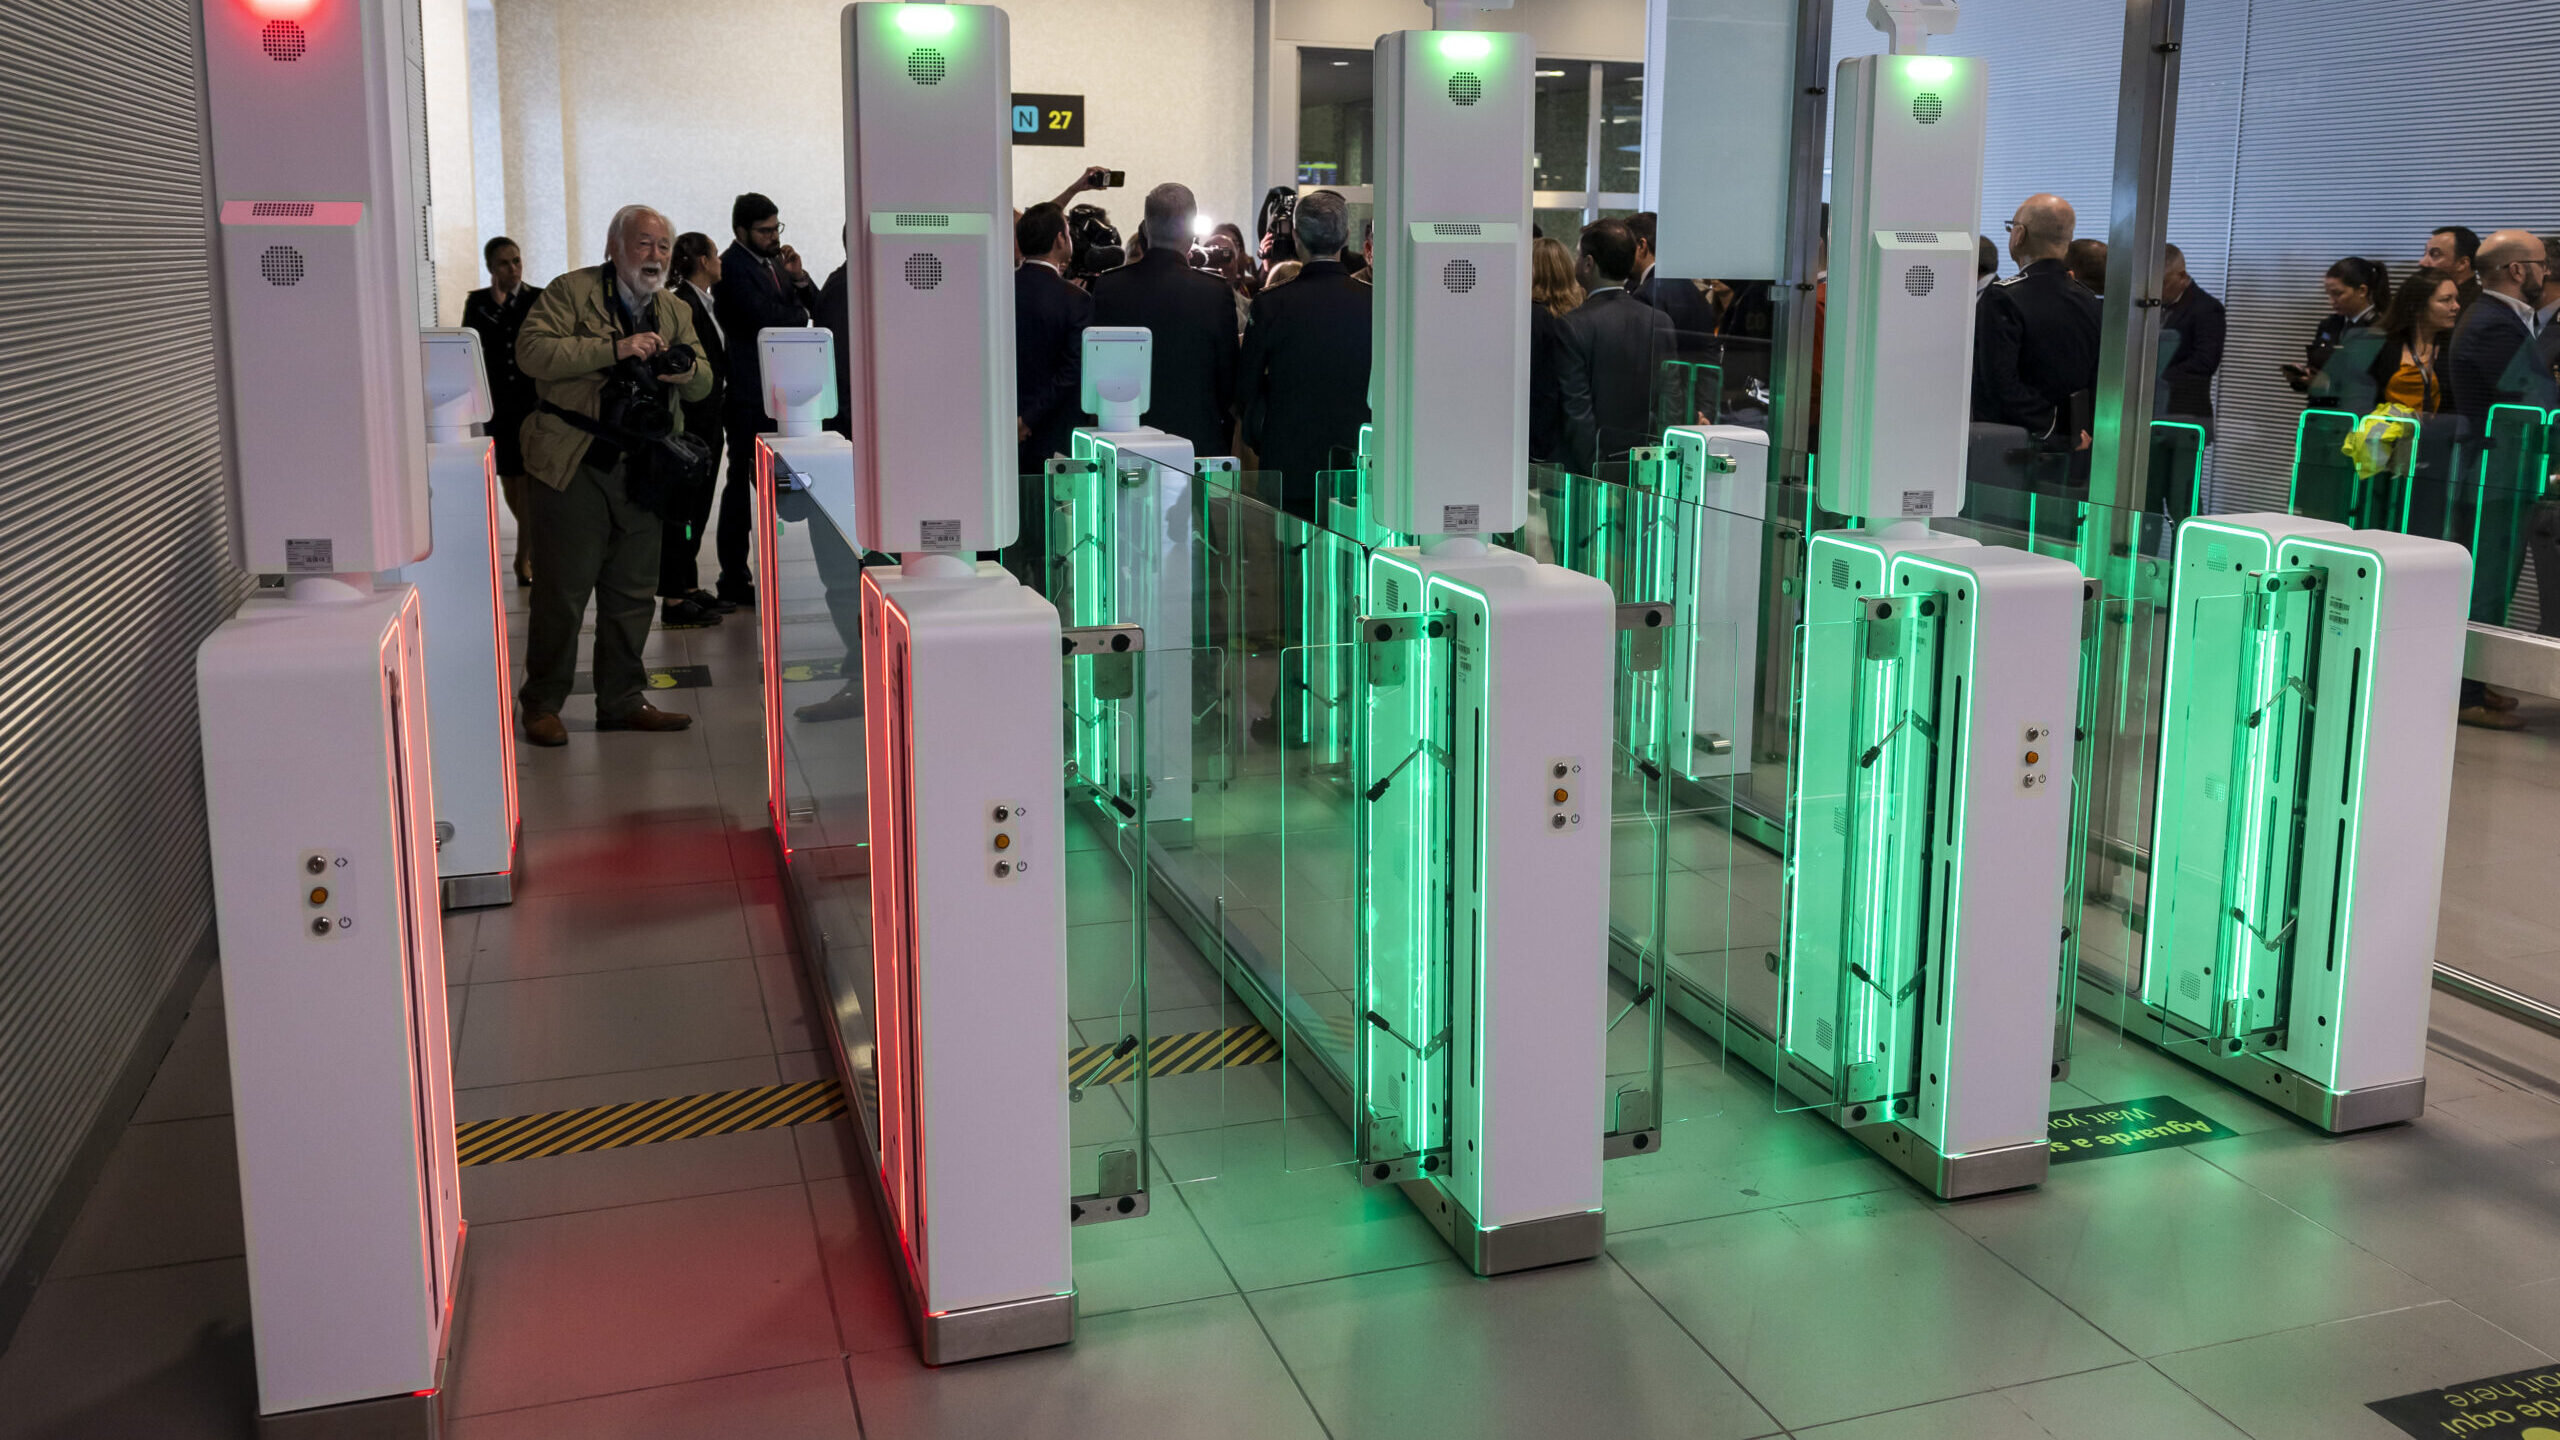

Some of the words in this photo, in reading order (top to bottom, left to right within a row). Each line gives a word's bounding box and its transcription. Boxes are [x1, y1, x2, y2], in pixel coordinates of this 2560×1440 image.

[1019, 111, 1033, 128] N
[1048, 110, 1073, 130] 27
[2086, 1107, 2156, 1125] Wait
[2095, 1120, 2212, 1146] Aguarde
[2049, 1141, 2071, 1153] s
[2071, 1138, 2093, 1150] a
[2513, 1372, 2560, 1395] ait
[2444, 1383, 2528, 1408] here
[2440, 1409, 2516, 1439] aqui
